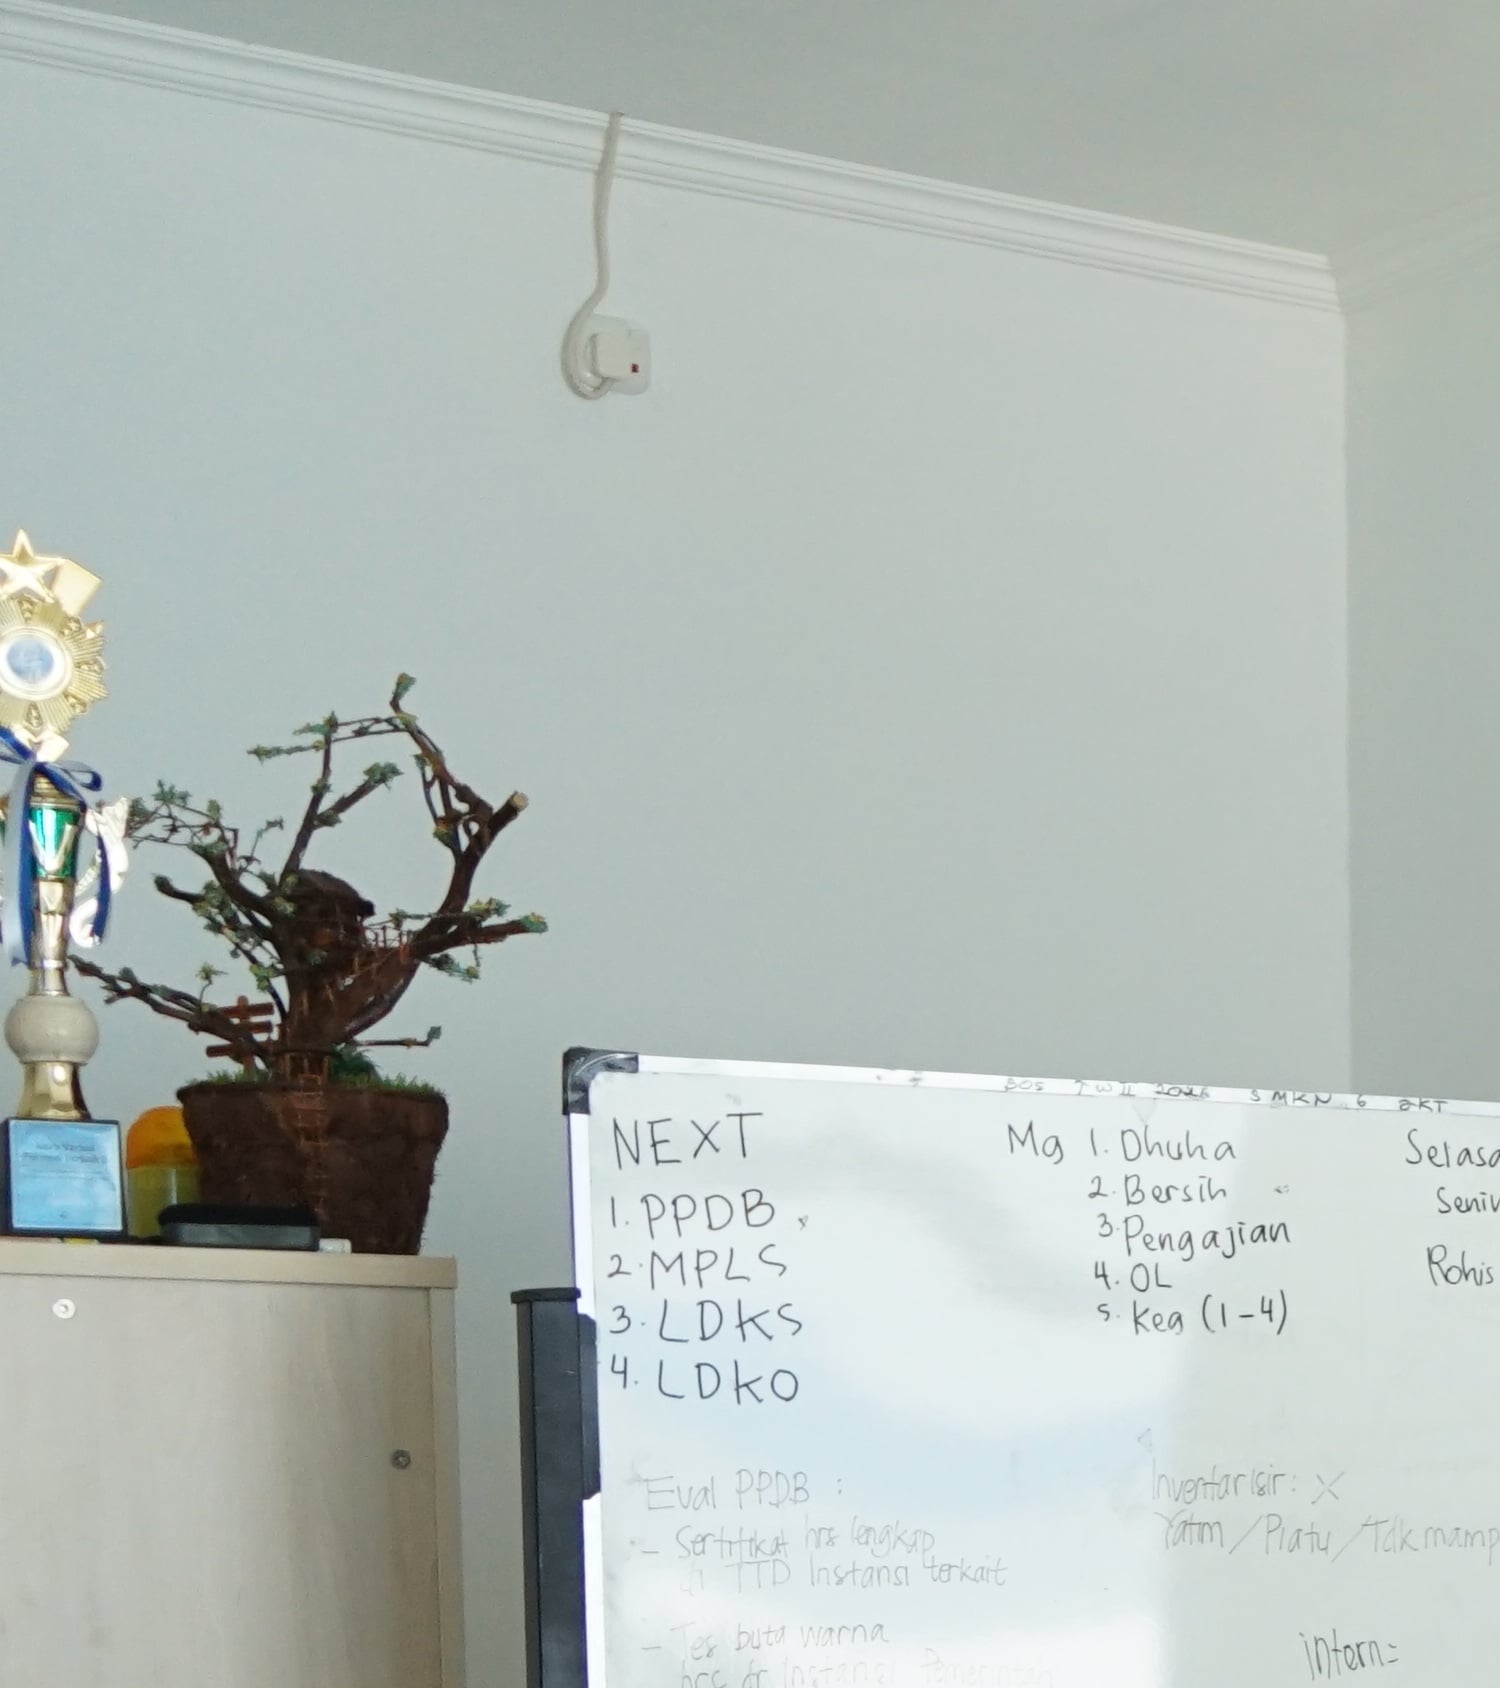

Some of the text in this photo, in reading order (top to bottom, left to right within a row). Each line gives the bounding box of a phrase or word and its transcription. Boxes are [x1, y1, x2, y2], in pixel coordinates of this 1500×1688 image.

[1356, 1094, 1367, 1108] 6
[613, 1112, 764, 1170] NEXT
[1008, 1120, 1064, 1165] Mg
[1120, 1124, 1237, 1162] Dhuha
[1124, 1173, 1228, 1207] Bersih
[640, 1188, 775, 1240] PPDB
[1122, 1213, 1291, 1262] Pengajian
[649, 1243, 787, 1291] MPLS
[1130, 1262, 1173, 1292] OL
[1427, 1244, 1495, 1287] Rohis
[658, 1298, 803, 1343] LDKS
[643, 1475, 717, 1511] Eval
[735, 1467, 810, 1511] PPDB
[805, 1513, 839, 1550] hrs
[850, 1514, 935, 1564] lengkap
[723, 1557, 792, 1594] TTD
[930, 1554, 1008, 1588] terkait
[800, 1621, 890, 1648] warna
